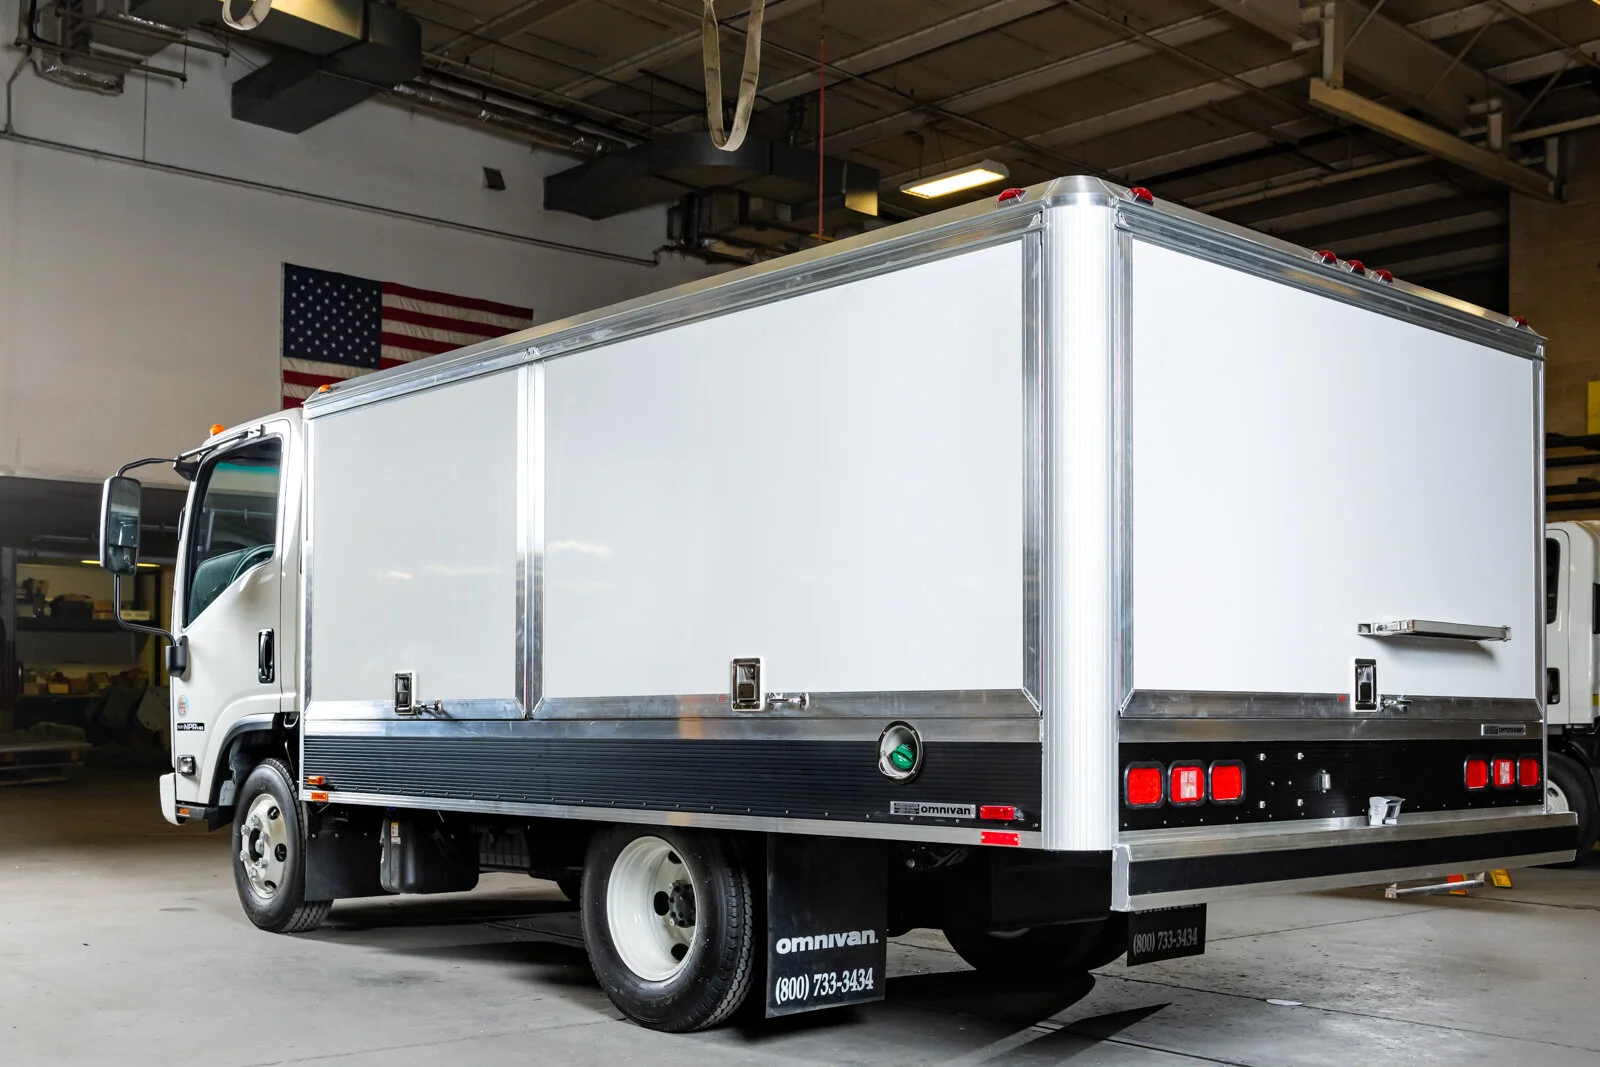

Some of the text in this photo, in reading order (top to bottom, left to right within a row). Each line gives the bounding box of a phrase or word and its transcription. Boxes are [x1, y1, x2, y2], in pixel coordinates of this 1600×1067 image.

[920, 805, 971, 816] omnivan
[1133, 927, 1199, 956] (800) 733-3434
[775, 967, 874, 1005] (800) 733-3434
